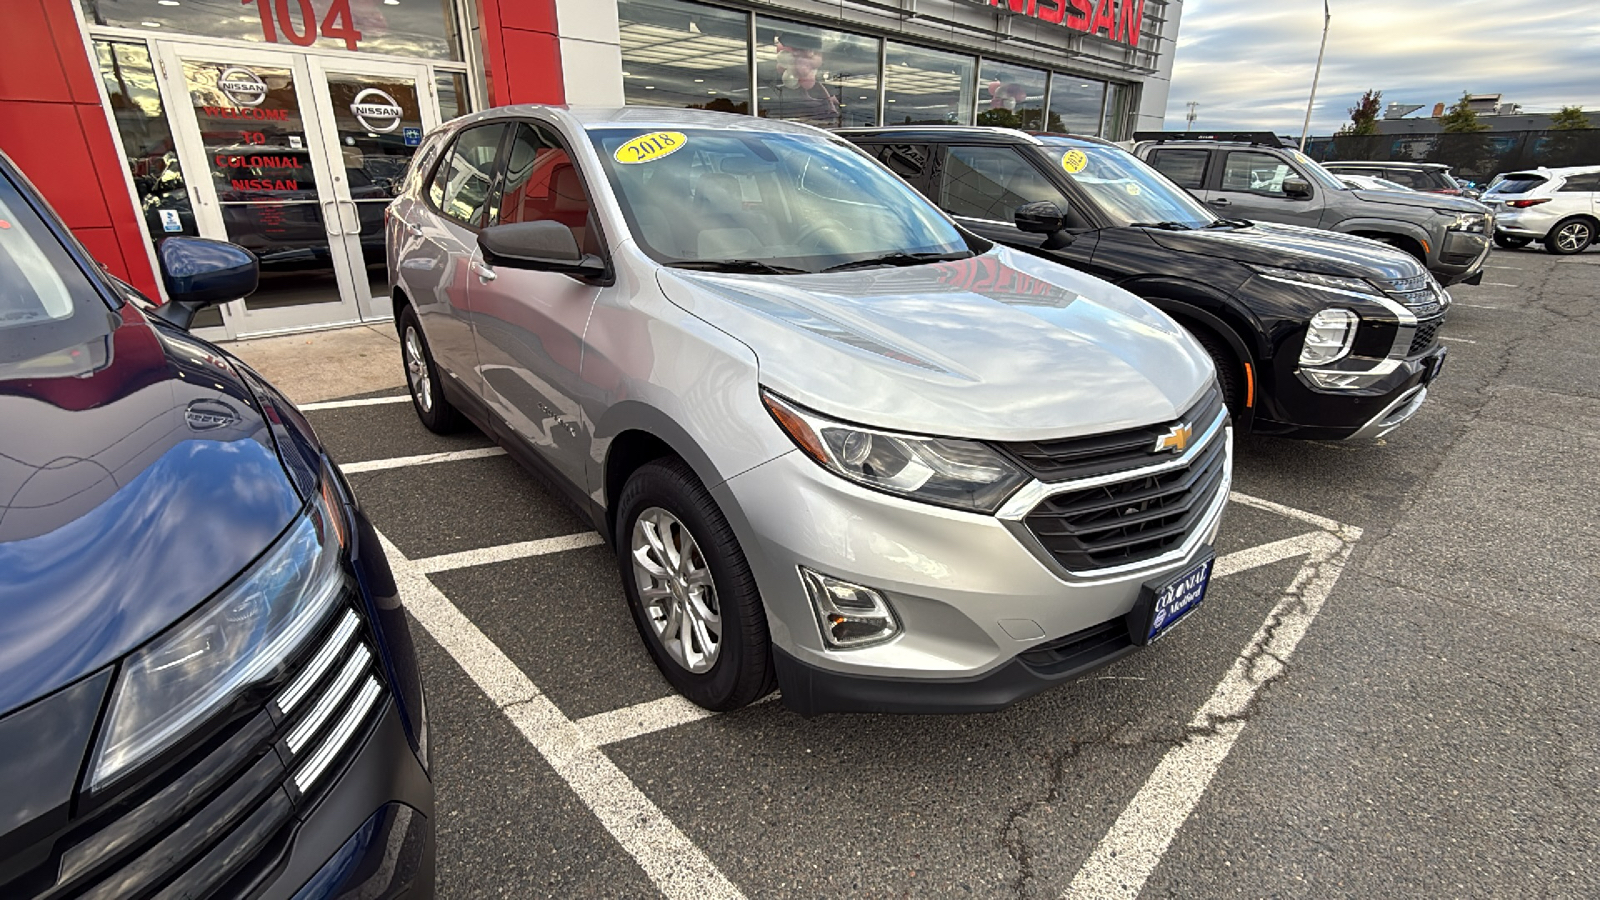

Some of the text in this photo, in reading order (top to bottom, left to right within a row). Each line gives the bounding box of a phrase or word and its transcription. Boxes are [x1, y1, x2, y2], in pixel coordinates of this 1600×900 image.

[242, 0, 362, 51] 104
[222, 82, 264, 92] NISSAN
[203, 106, 289, 122] WELCOME
[356, 106, 398, 116] NISSAN
[241, 131, 265, 145] TO
[628, 133, 675, 160] 2018
[215, 155, 303, 168] COLONIAL
[232, 179, 298, 191] NISSAN
